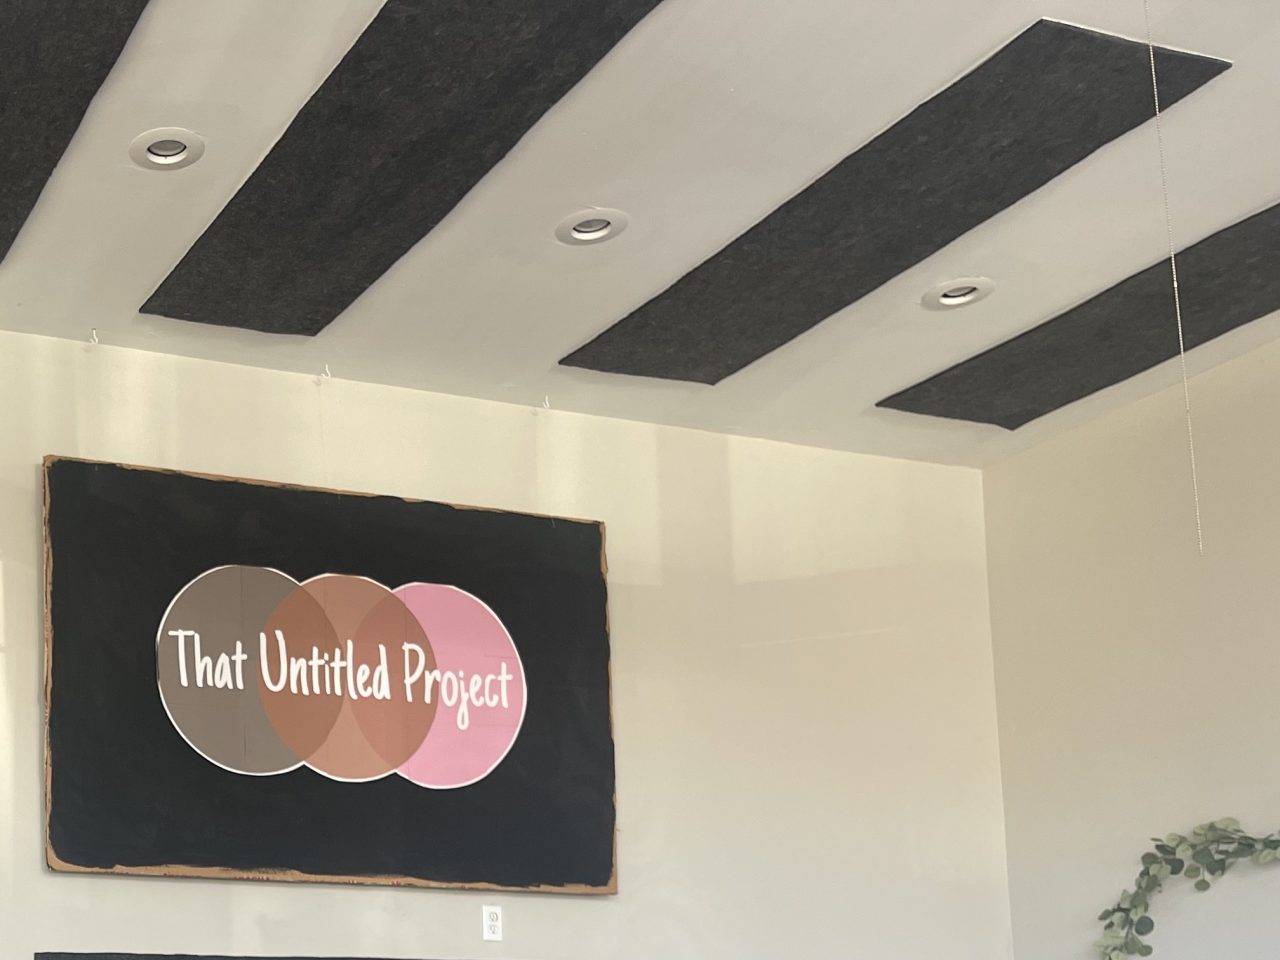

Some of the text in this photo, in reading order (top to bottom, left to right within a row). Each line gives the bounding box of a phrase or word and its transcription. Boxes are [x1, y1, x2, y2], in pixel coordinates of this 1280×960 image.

[167, 628, 514, 731] That Untitled Project
